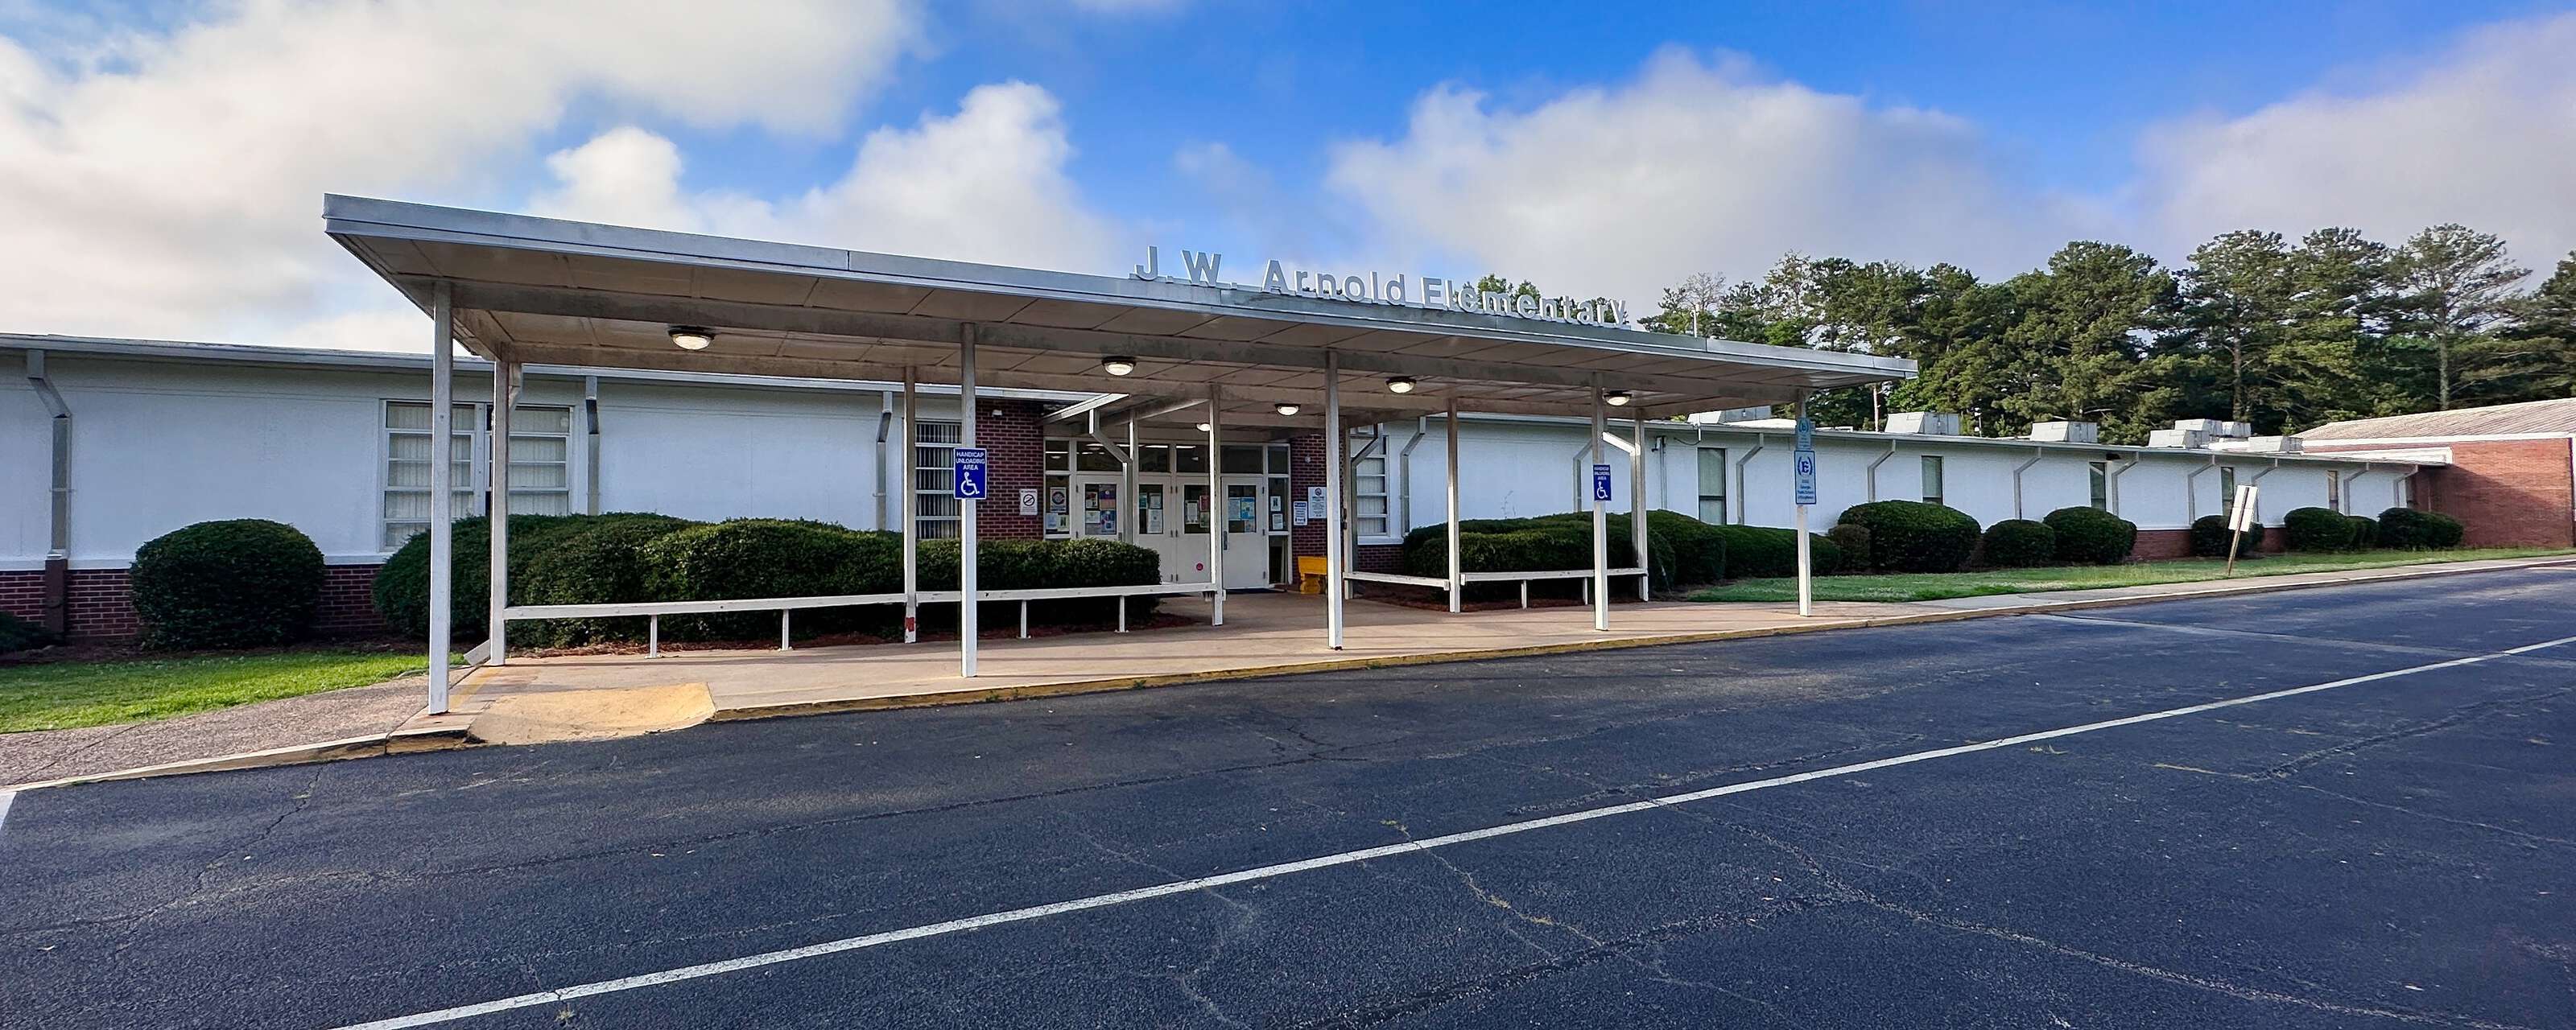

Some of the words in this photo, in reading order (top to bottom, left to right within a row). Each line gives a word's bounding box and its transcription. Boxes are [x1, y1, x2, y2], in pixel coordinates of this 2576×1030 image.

[1134, 245, 1174, 283] J.
[1181, 249, 1237, 290] W.
[1261, 259, 1406, 306] Arnold
[1420, 277, 1626, 328] Elementary
